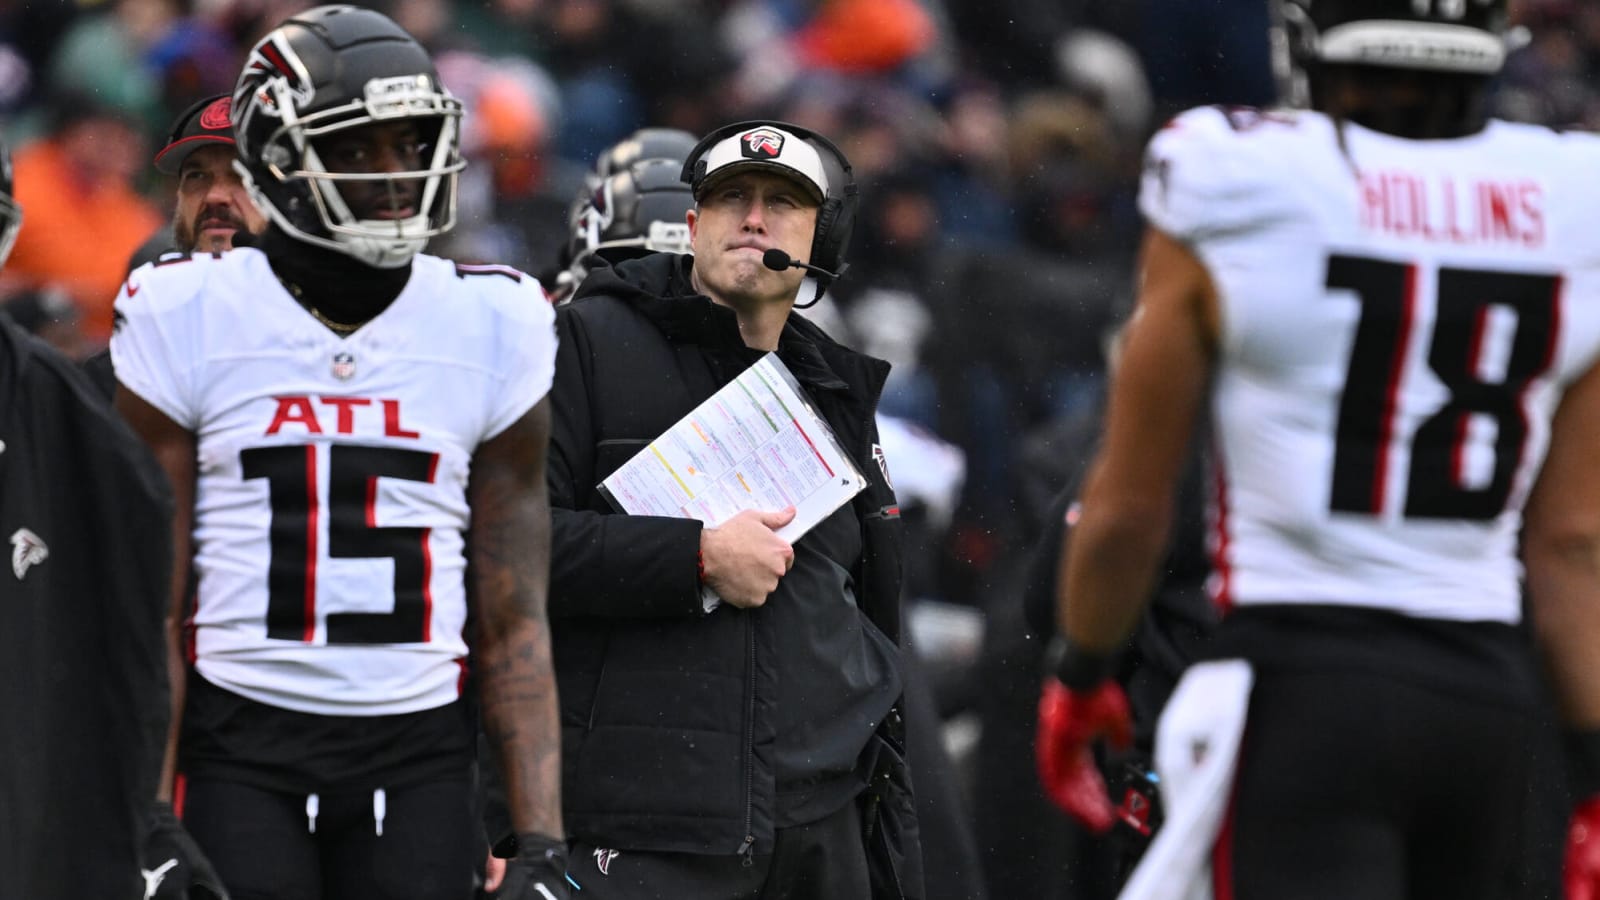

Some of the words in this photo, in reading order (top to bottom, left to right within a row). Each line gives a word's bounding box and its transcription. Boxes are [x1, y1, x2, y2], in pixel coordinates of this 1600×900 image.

[1360, 172, 1546, 247] HOLLINS
[264, 395, 420, 440] ATL
[1324, 254, 1568, 520] 18
[239, 443, 441, 644] 15
